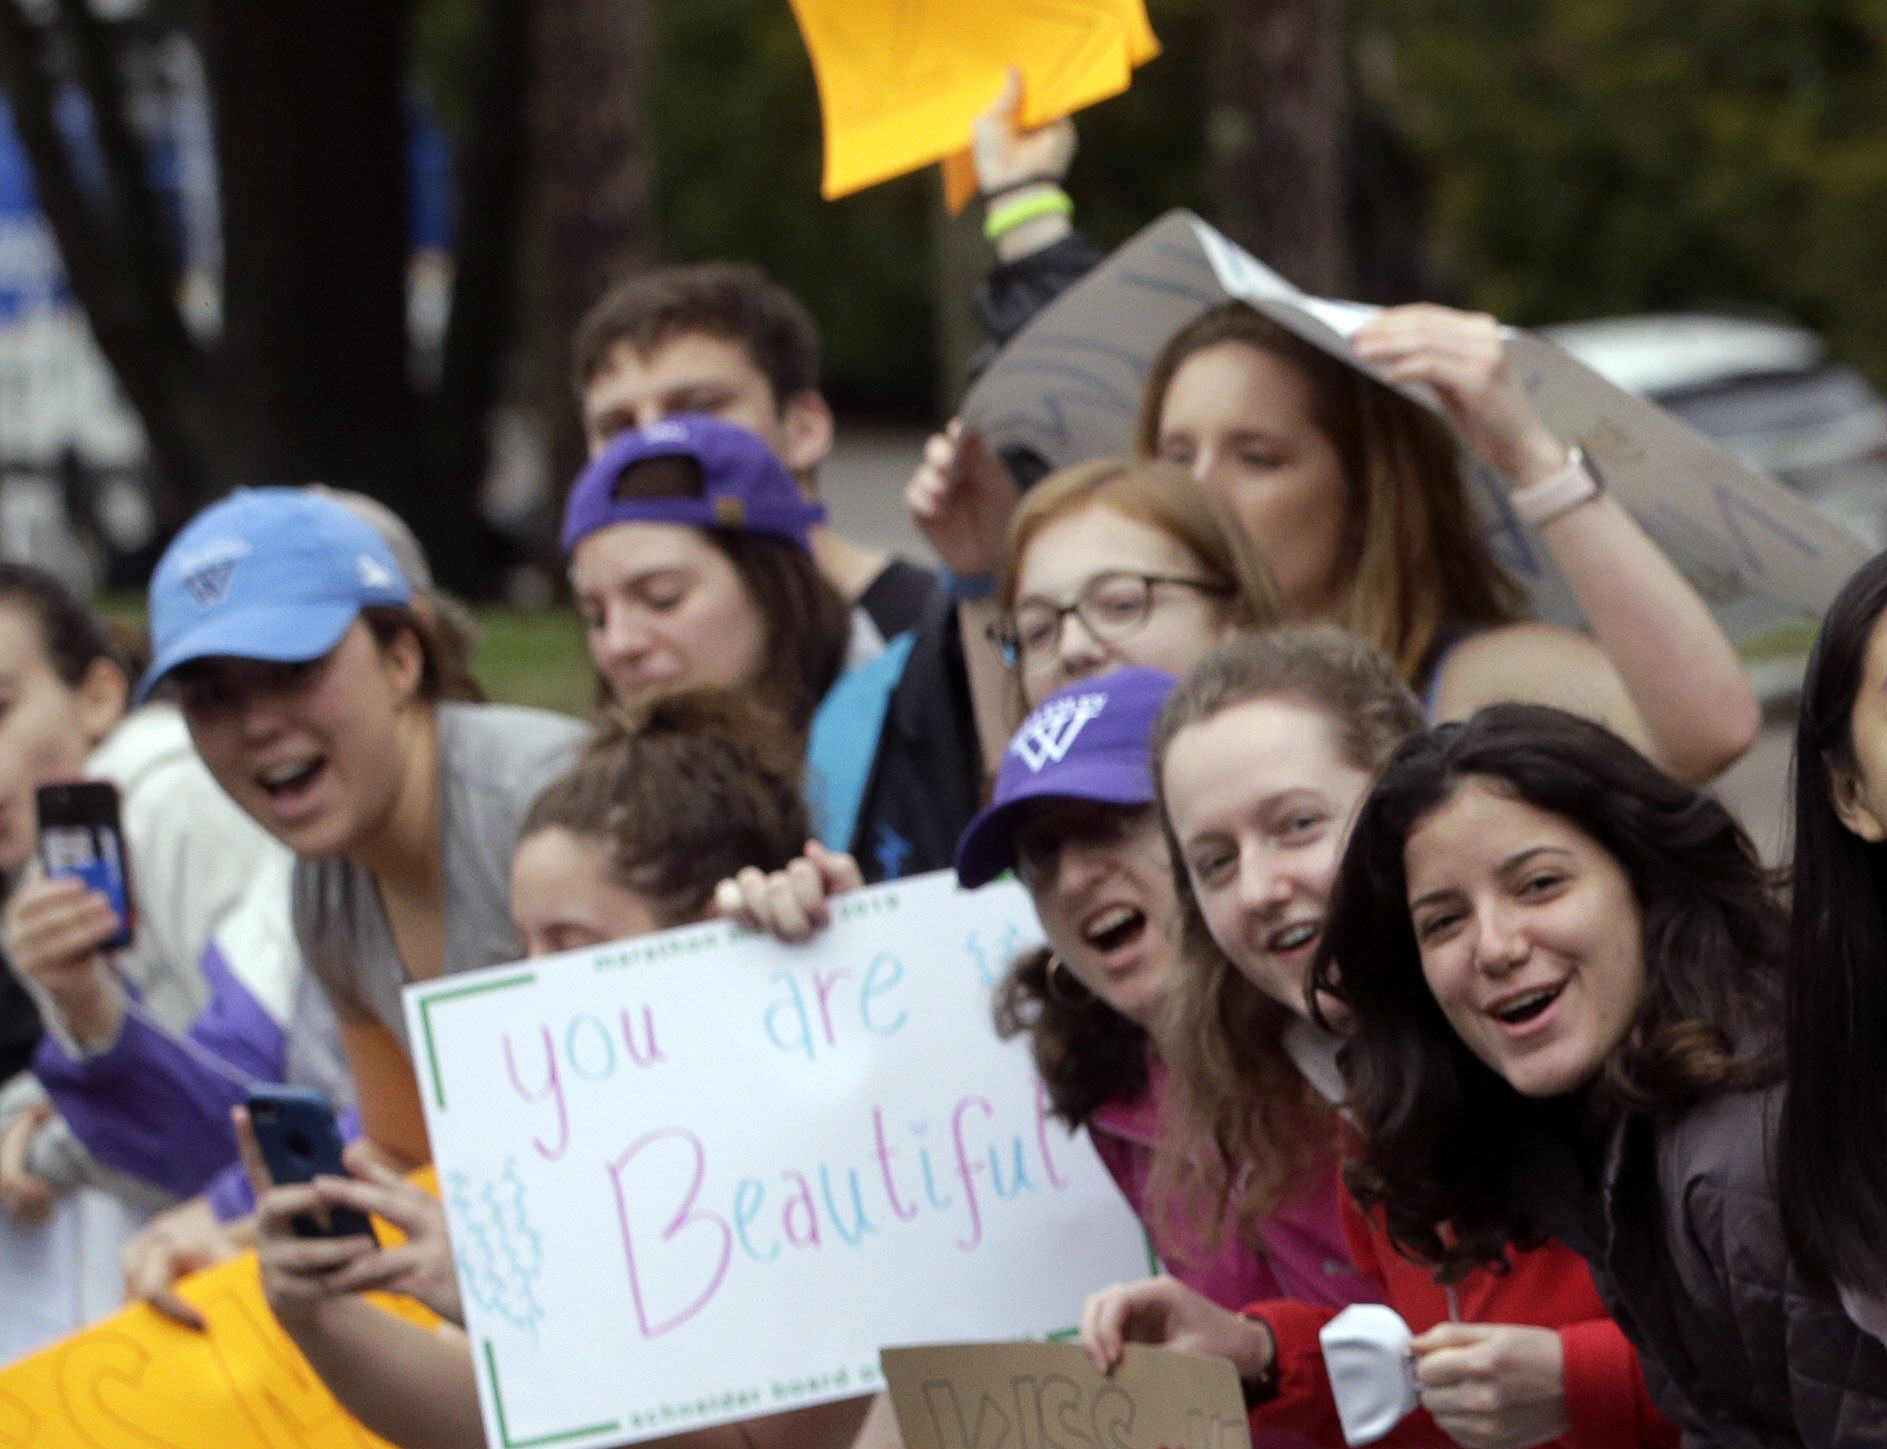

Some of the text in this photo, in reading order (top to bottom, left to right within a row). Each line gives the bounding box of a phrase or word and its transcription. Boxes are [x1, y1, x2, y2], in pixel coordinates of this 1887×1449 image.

[503, 951, 910, 1162] you are
[606, 1080, 1071, 1337] Beautiful
[628, 1384, 762, 1429] schneider
[770, 1365, 851, 1399] board
